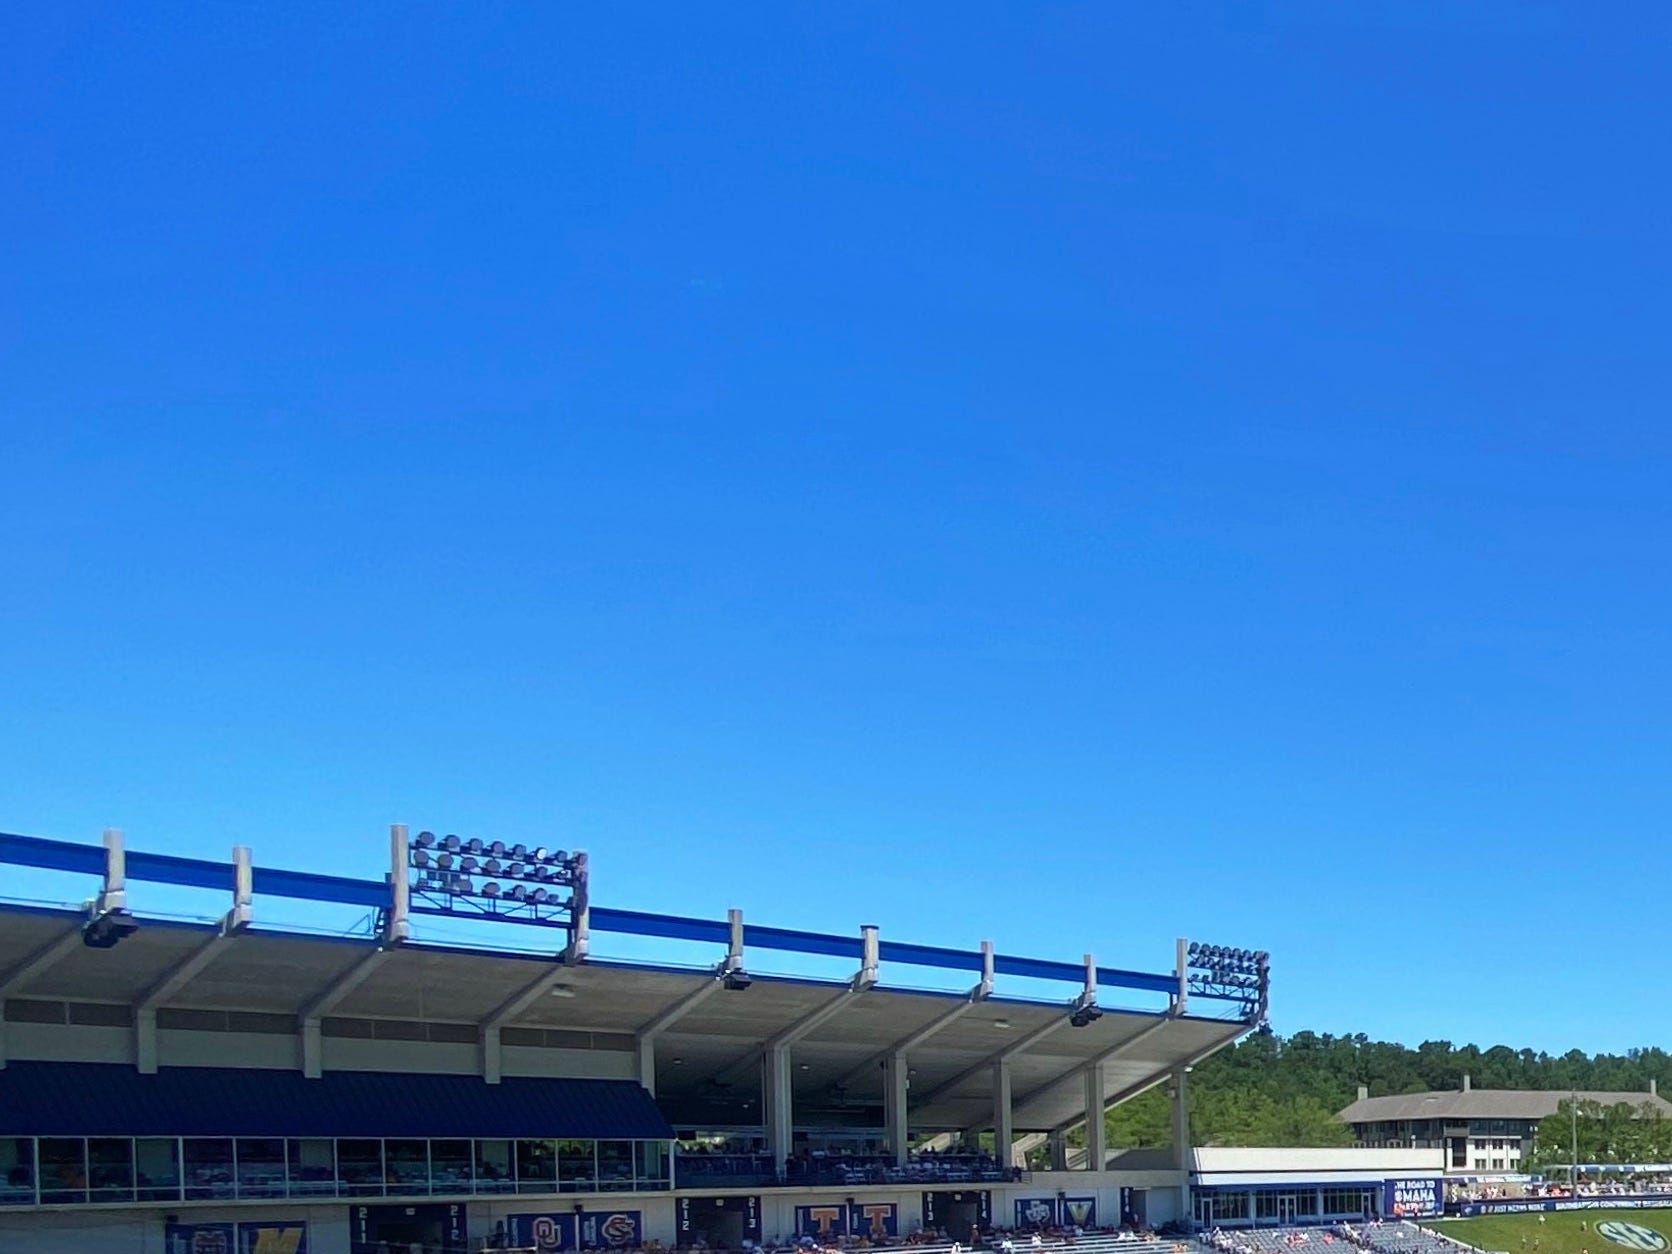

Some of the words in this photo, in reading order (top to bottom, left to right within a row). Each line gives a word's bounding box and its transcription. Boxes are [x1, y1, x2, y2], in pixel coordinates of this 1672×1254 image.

[359, 1207, 368, 1244] 211
[450, 1205, 460, 1241] 212
[681, 1198, 689, 1231] 212
